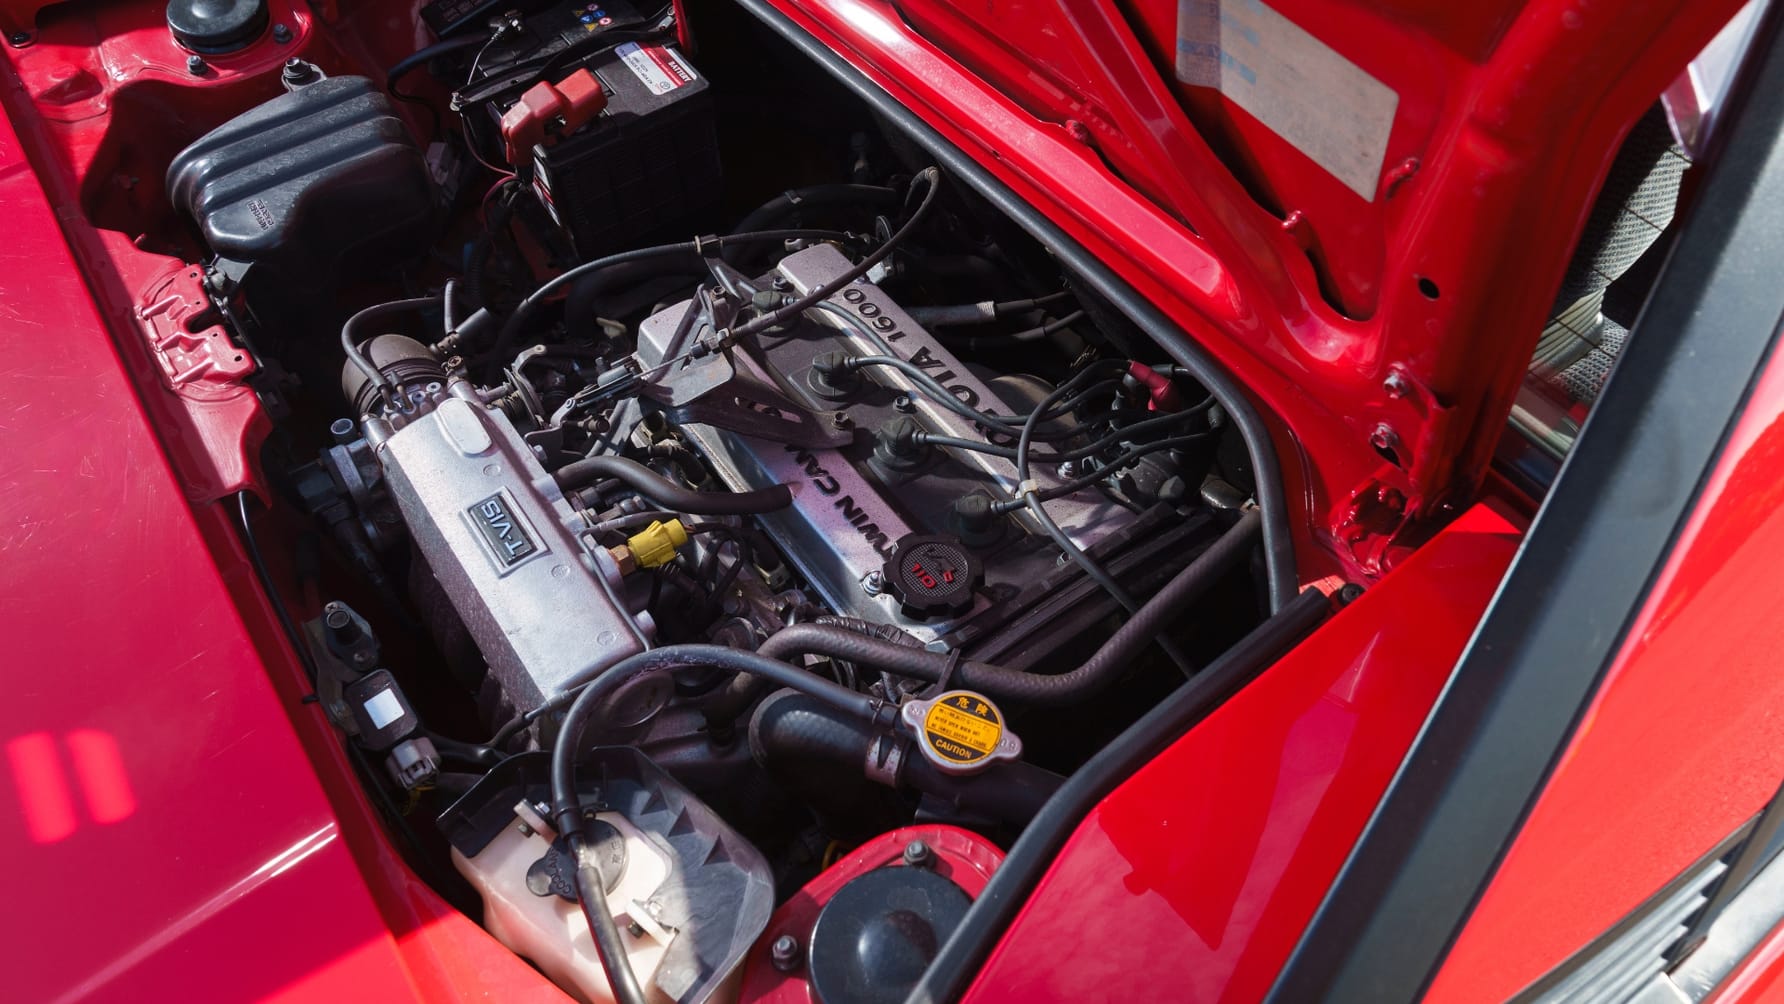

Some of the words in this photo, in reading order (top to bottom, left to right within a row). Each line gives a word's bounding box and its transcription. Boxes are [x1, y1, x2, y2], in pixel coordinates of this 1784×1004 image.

[667, 60, 693, 82] BATTERY
[843, 288, 905, 343] 1600
[481, 500, 524, 557] T-VIS
[910, 562, 938, 590] OIL
[935, 738, 972, 759] CAUTION
